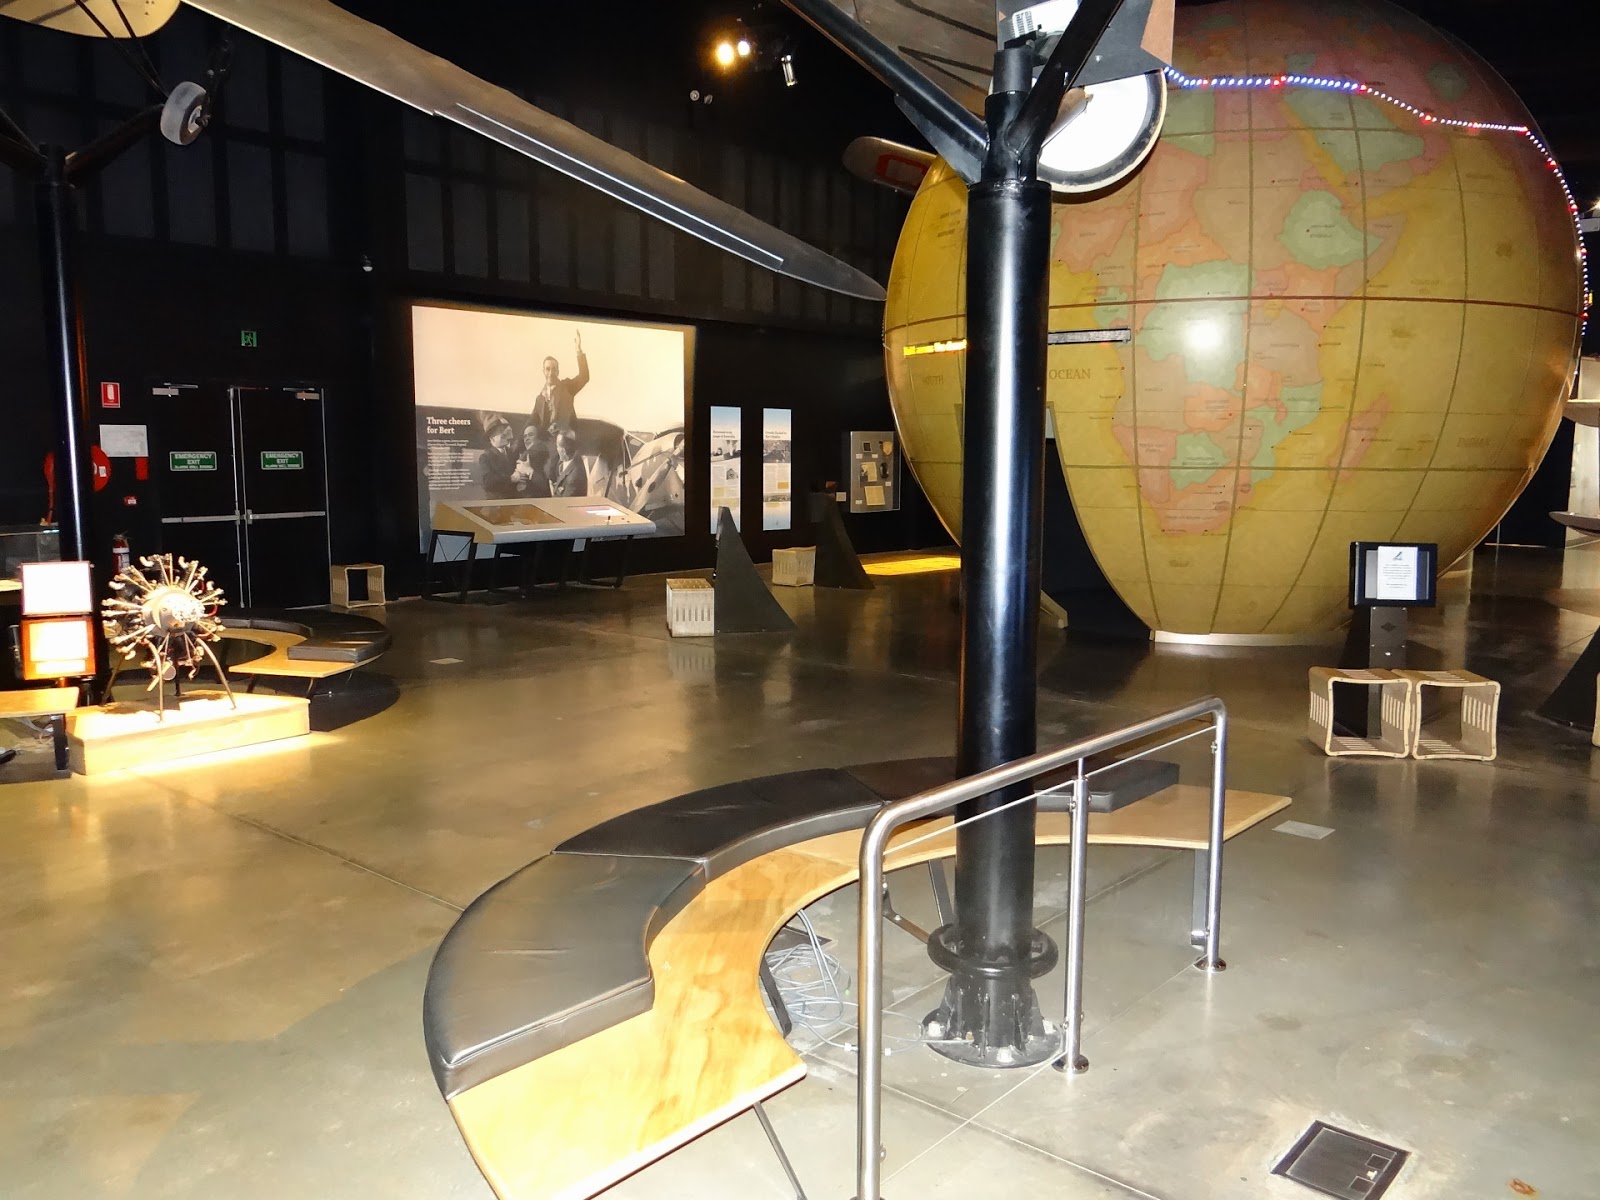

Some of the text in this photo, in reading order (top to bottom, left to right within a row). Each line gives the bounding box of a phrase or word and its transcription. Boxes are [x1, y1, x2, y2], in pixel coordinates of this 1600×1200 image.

[1048, 368, 1092, 380] OCEAN
[426, 416, 471, 425] Three cheers
[427, 426, 438, 434] for
